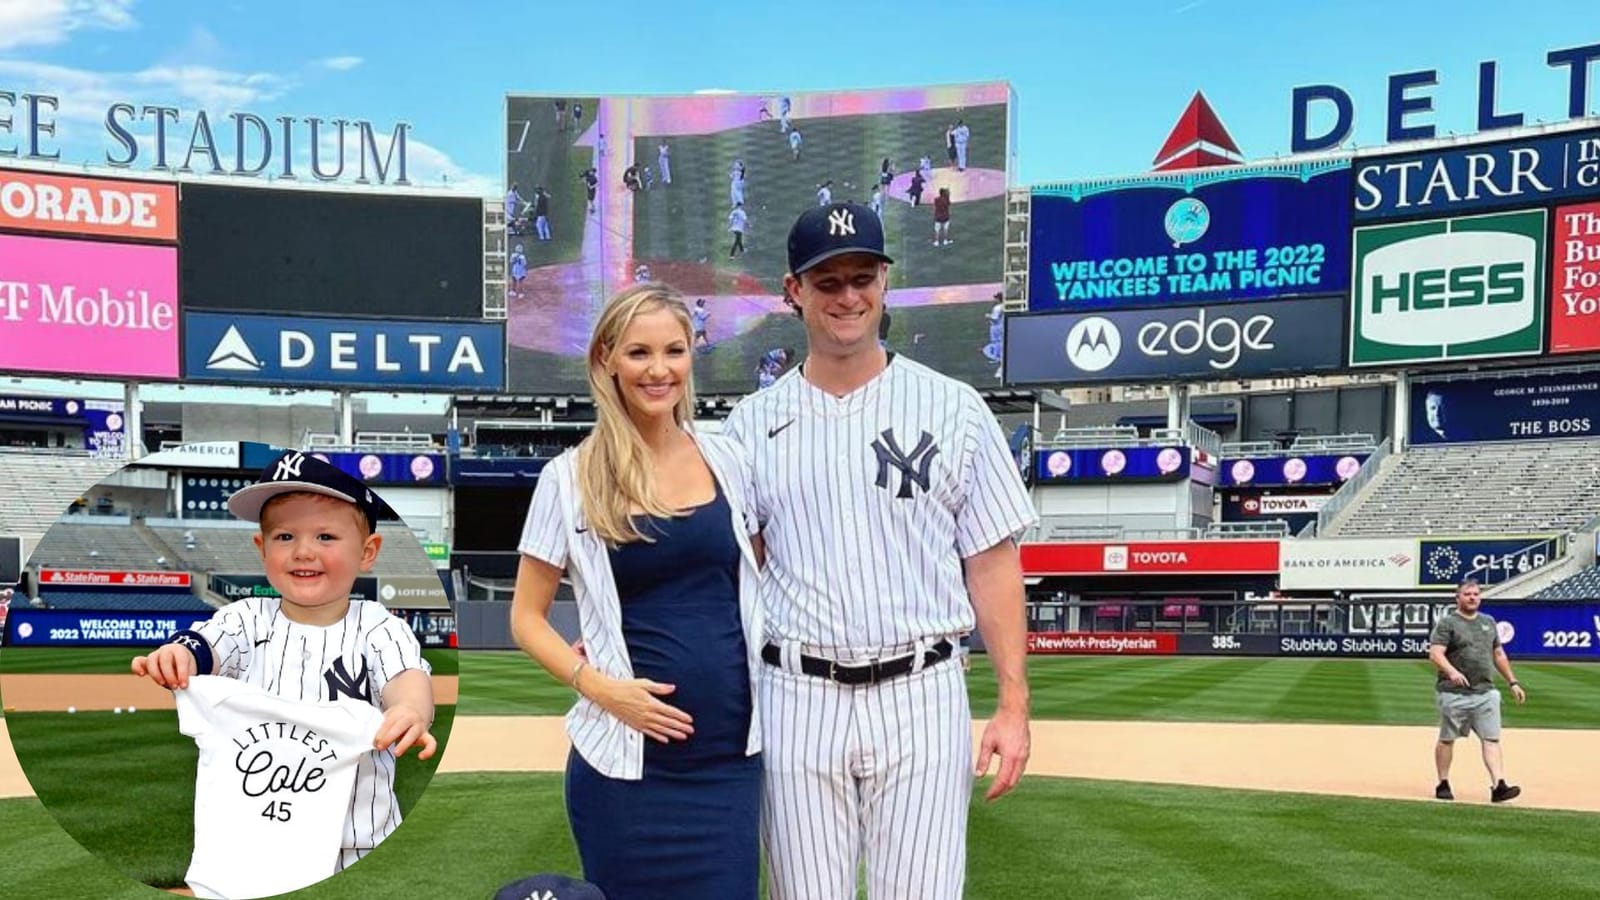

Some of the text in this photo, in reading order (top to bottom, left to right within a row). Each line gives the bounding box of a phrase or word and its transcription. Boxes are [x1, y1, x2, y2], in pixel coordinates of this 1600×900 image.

[1291, 43, 1600, 153] DELT
[106, 102, 412, 186] STADIUM
[1354, 147, 1553, 211] STARR
[0, 181, 158, 228] ORADE
[828, 208, 856, 237] NY
[1051, 243, 1325, 281] WELCOME TO THE 2022
[1055, 264, 1321, 301] YANKEES TEAM PICNIC
[1371, 262, 1525, 315] HESS
[1564, 265, 1600, 290] Fo
[37, 283, 174, 331] Mobile
[1562, 292, 1600, 316] Yo
[1138, 308, 1275, 369] edge
[279, 330, 484, 373] DELTA
[18, 400, 53, 411] PICNIC
[1509, 418, 1591, 435] THE BOSS
[271, 452, 305, 481] NY
[870, 427, 940, 499] NY
[1262, 499, 1309, 510] TOYOTA
[1132, 552, 1188, 564] TOYOTA
[1284, 560, 1317, 568] BANK
[1334, 558, 1386, 568] AMERICA
[1472, 553, 1546, 573] CLEAR
[225, 583, 253, 596] Uber
[398, 588, 426, 597] LOTTE
[50, 629, 79, 640] 2022
[81, 630, 133, 640] YANKEES
[136, 630, 165, 640] TEAM
[80, 619, 177, 630] WELCOME TO THE
[1212, 635, 1234, 649] 385
[1281, 638, 1337, 651] StubHub
[1342, 639, 1397, 652] StubHub
[1543, 631, 1592, 648] 2022
[233, 722, 337, 762] LITTLEST
[236, 751, 326, 796] Cole
[261, 801, 292, 822] 45
